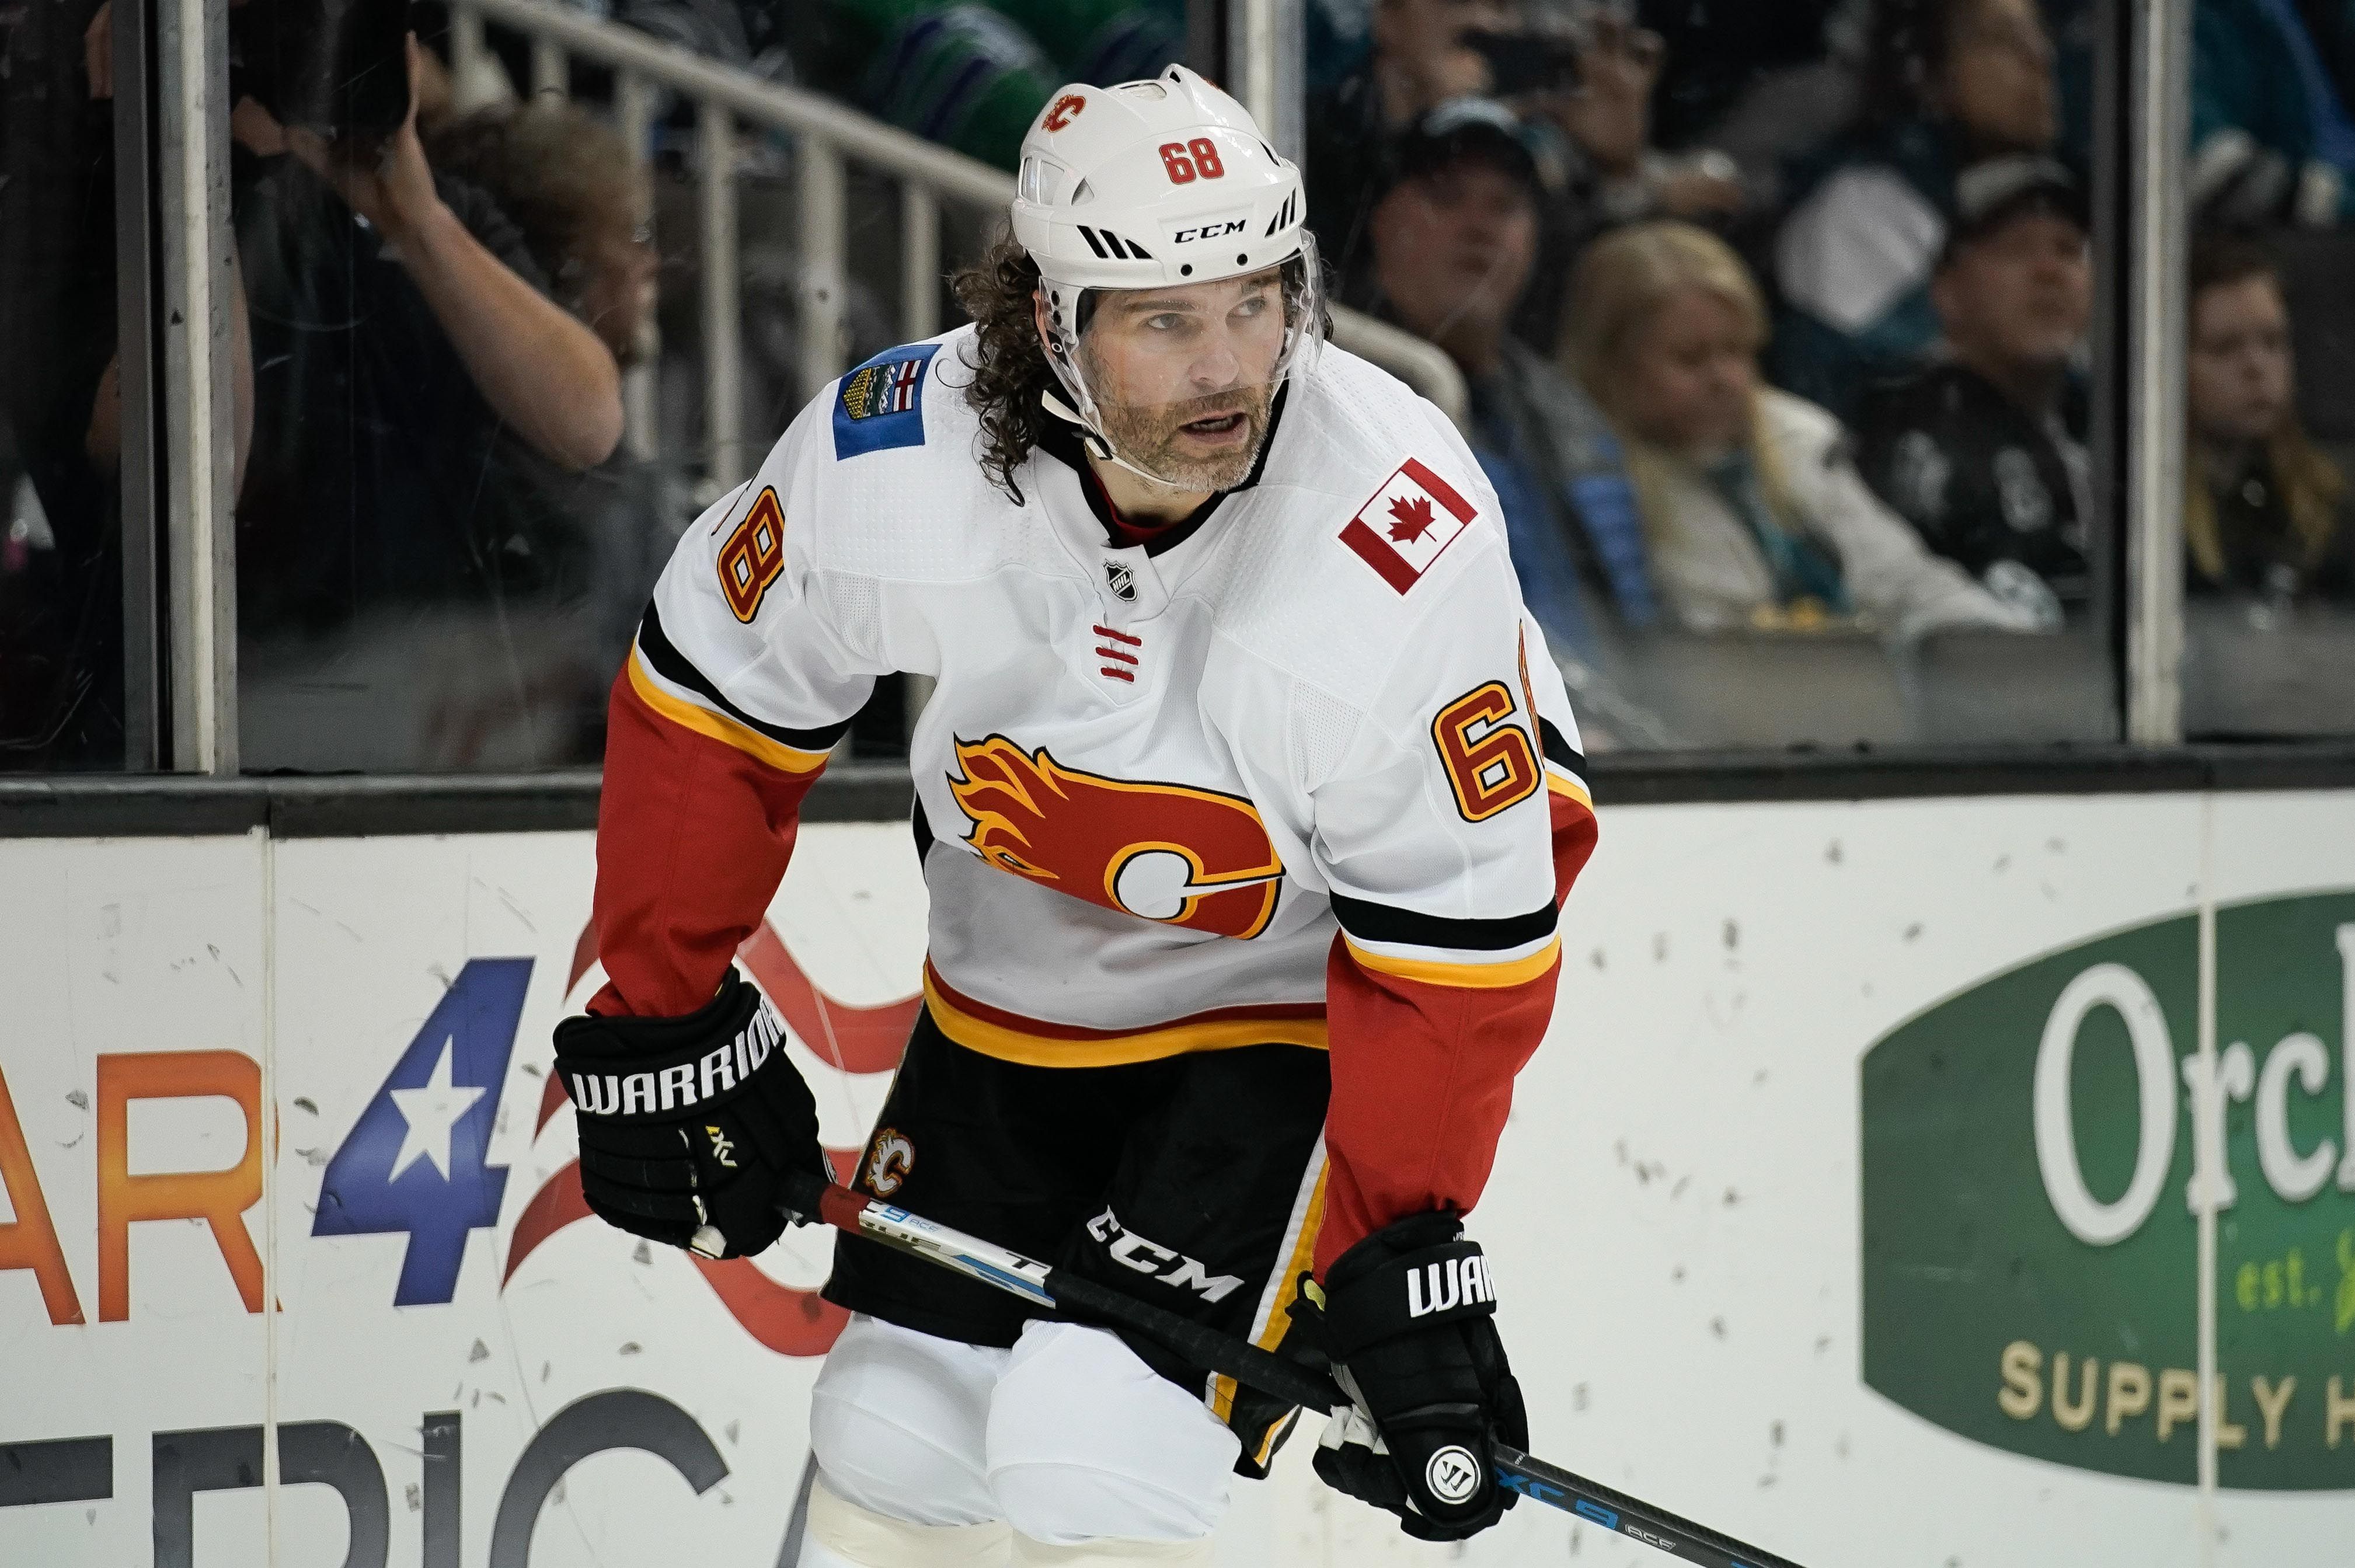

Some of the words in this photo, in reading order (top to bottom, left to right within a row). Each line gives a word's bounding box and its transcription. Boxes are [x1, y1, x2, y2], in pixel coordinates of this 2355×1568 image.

[1158, 137, 1225, 186] 68
[1174, 219, 1247, 244] CCM
[710, 470, 785, 624] 8
[1112, 573, 1130, 593] NHL
[1431, 618, 1545, 823] 6
[572, 994, 784, 1116] WARRIOR
[1086, 1204, 1245, 1304] CCM
[1997, 1340, 2297, 1449] SUPPLY
